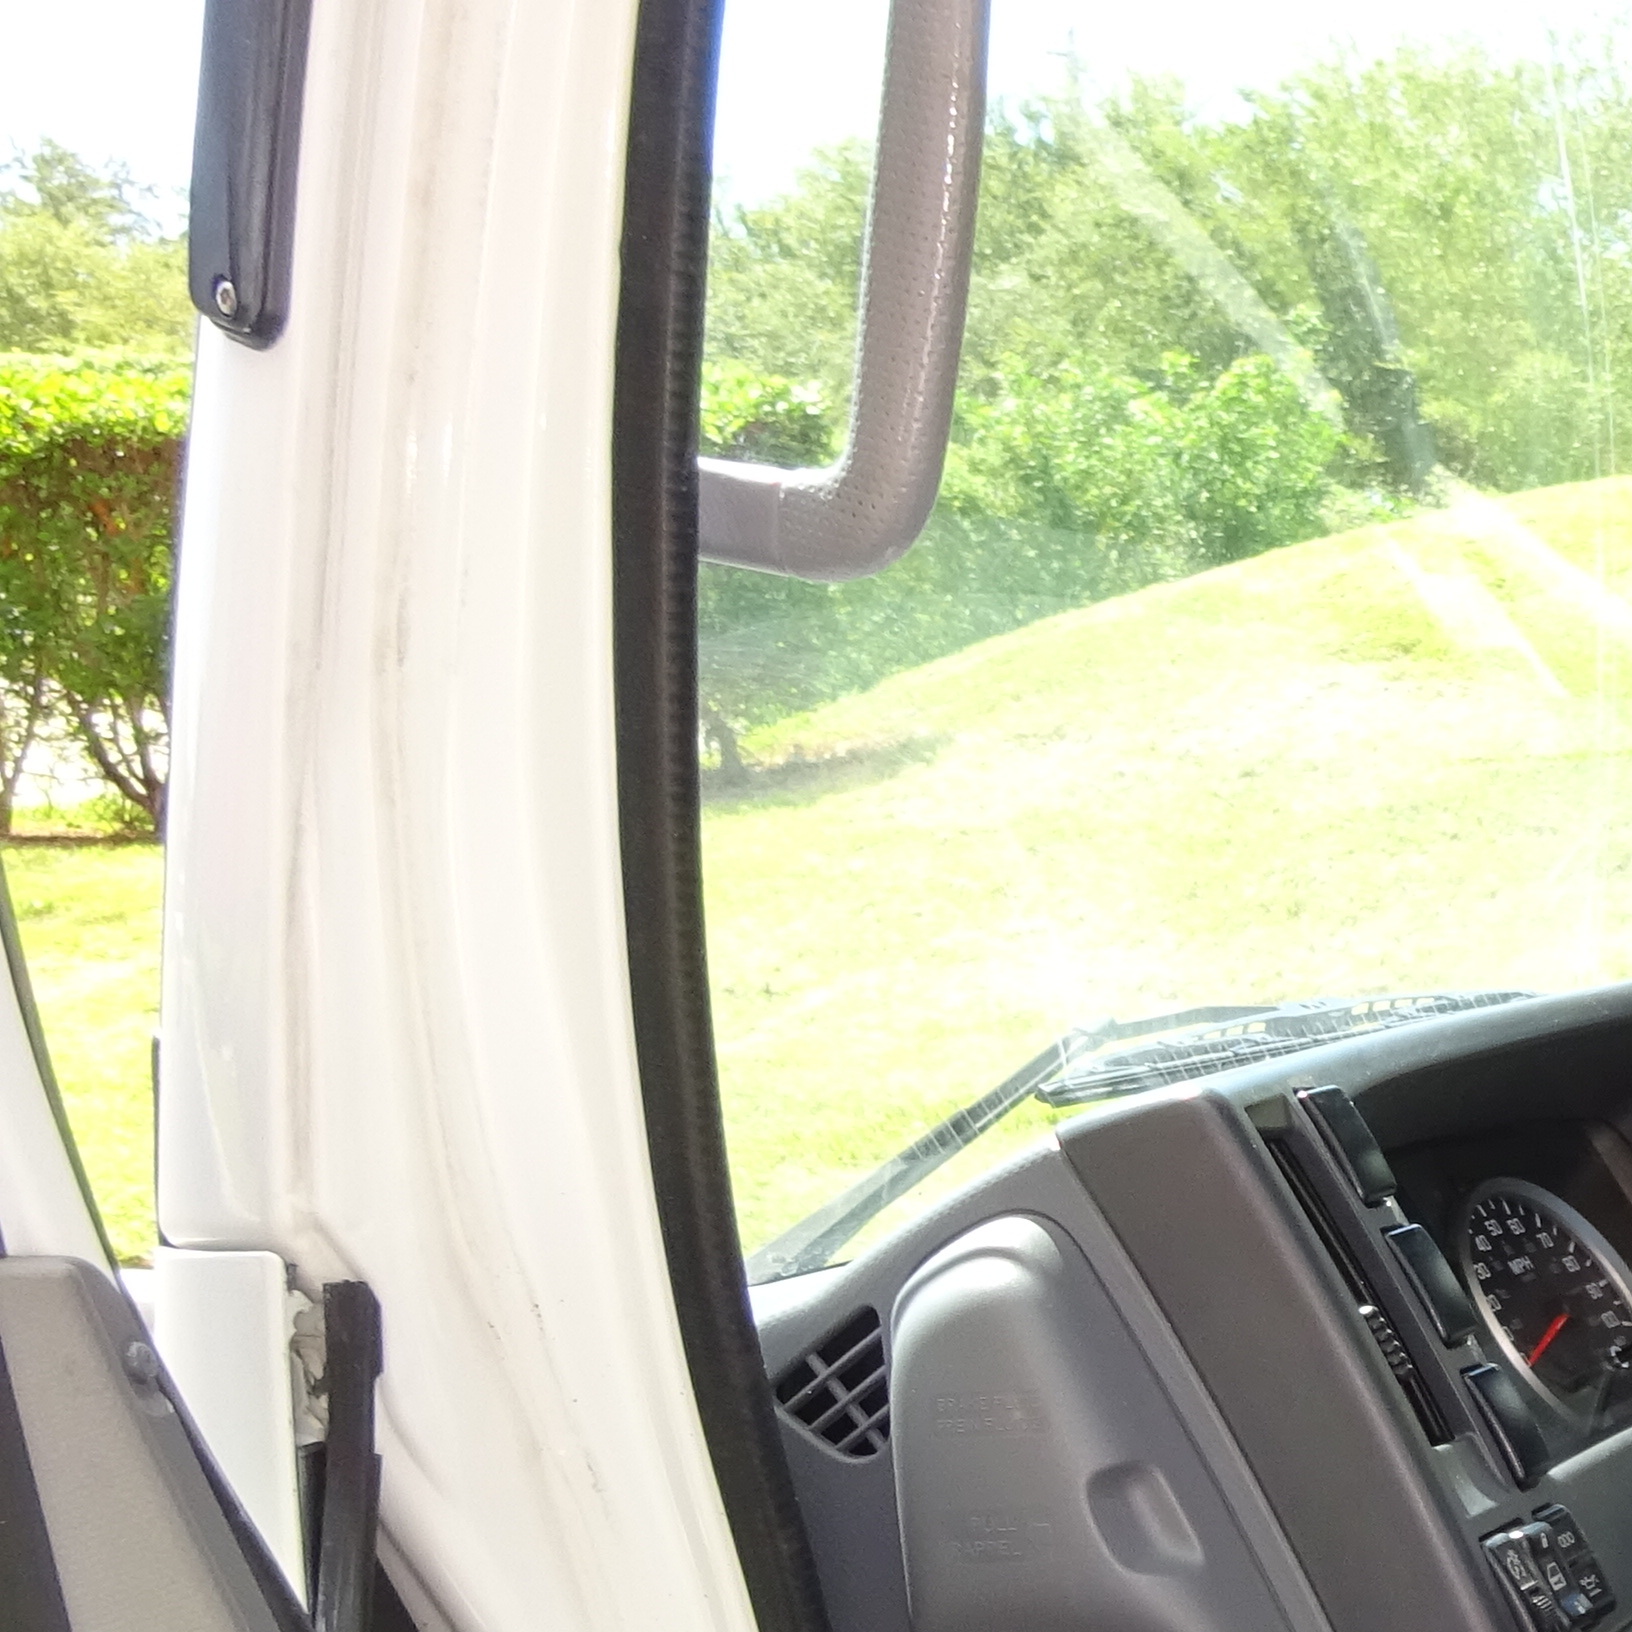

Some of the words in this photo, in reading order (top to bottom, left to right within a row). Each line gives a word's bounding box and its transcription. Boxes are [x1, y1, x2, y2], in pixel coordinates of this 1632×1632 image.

[1484, 1219, 1503, 1237] 50
[1506, 1217, 1526, 1236] 60
[1475, 1236, 1492, 1253] 40
[1536, 1232, 1554, 1249] 70
[1473, 1262, 1492, 1280] 30
[1507, 1255, 1535, 1276] MPH
